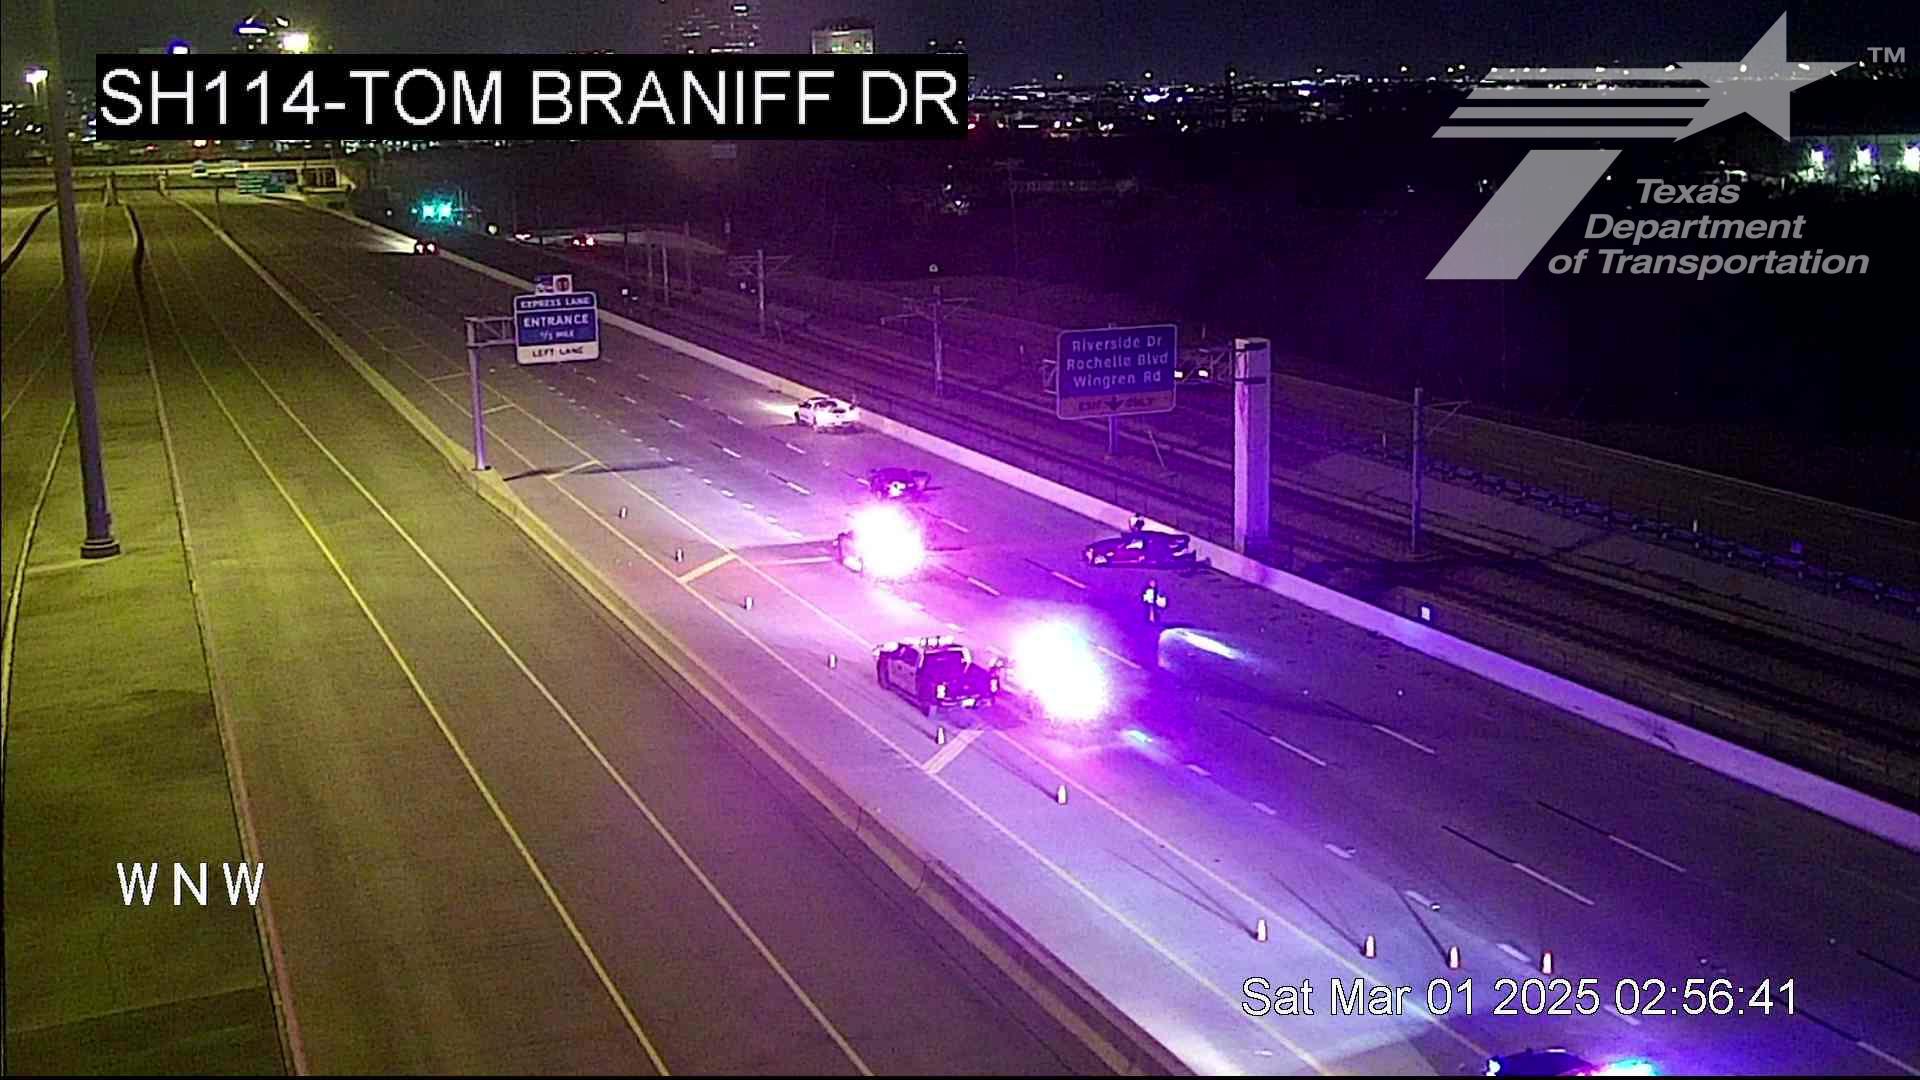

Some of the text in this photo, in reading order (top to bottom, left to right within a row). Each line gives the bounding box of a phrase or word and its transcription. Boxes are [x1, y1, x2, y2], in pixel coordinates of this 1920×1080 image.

[565, 297, 591, 306] LANE
[523, 313, 589, 328] ENTRANCE
[1072, 335, 1163, 352] Riverside Dr
[1066, 352, 1169, 371] Rochelle Blvd
[1073, 370, 1161, 389] Wingren Rd
